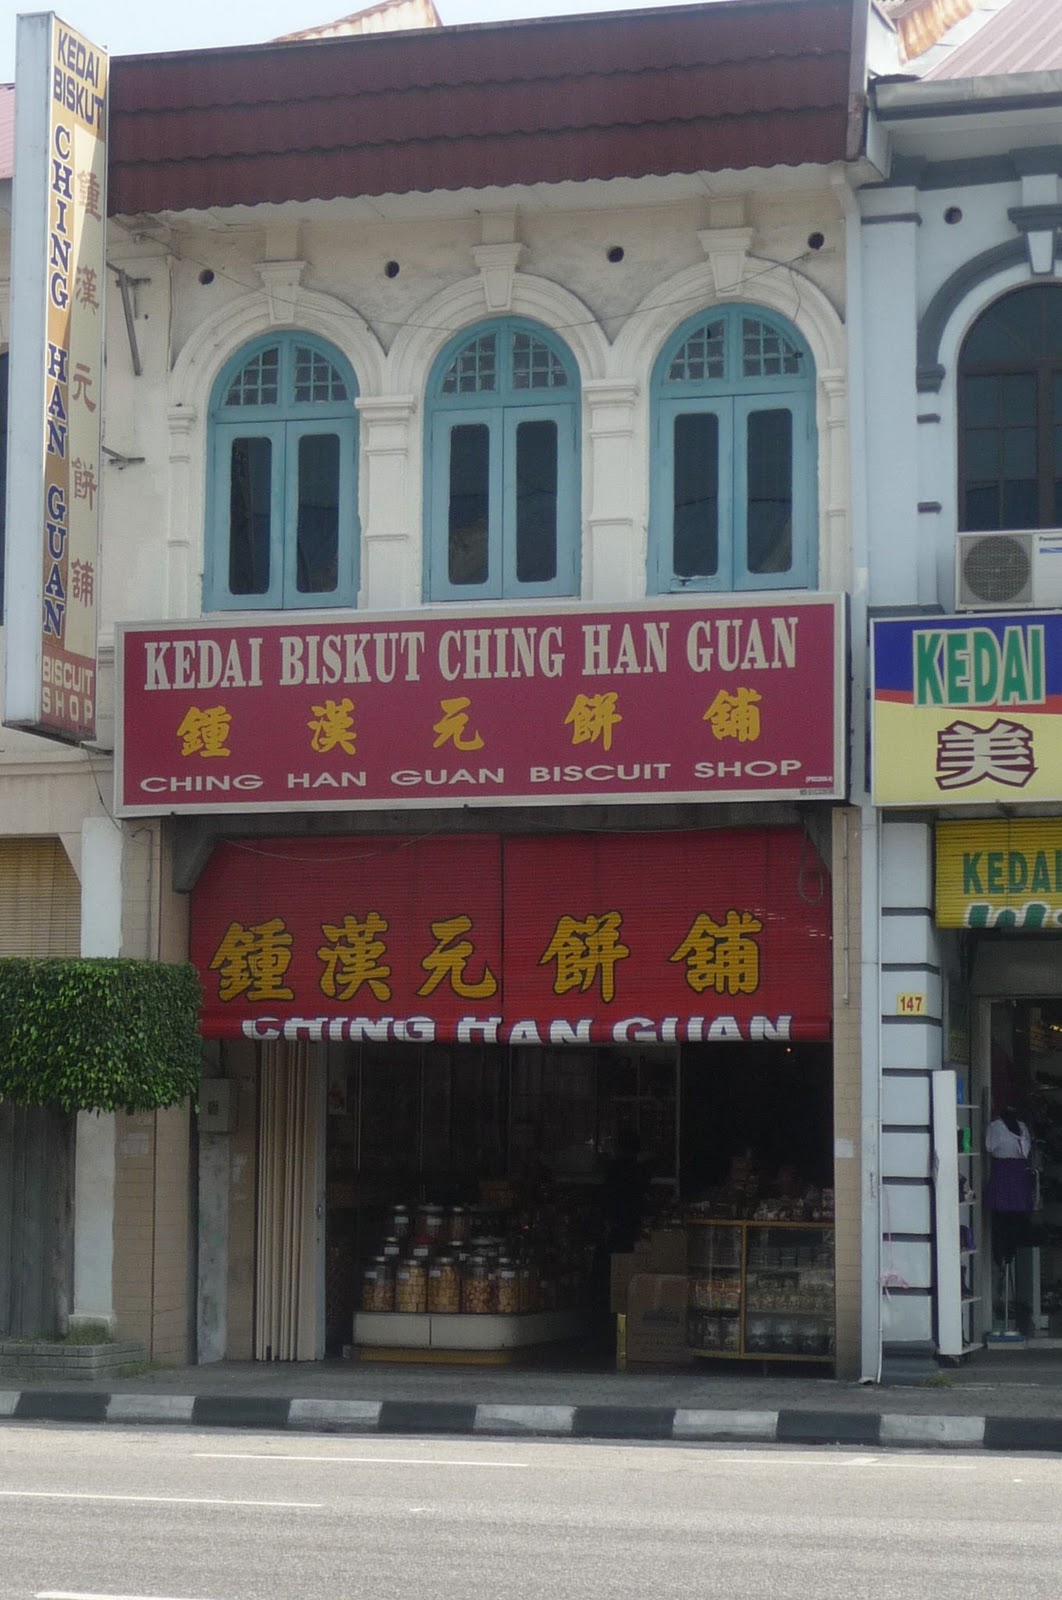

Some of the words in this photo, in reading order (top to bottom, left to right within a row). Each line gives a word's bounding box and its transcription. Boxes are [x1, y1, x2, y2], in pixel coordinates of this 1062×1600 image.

[58, 28, 100, 89] KEDAI
[53, 66, 103, 130] BISKUT
[51, 124, 73, 311] CHING
[46, 342, 69, 460] HAN
[43, 484, 68, 640] GUAN
[42, 655, 94, 695] BISCUIT
[144, 637, 264, 691] KEDAI
[279, 631, 425, 686] BISKUT
[438, 626, 565, 681] CHING
[581, 622, 670, 676] HAN
[687, 616, 799, 673] GUAN
[912, 623, 1046, 708] KEDAI
[42, 686, 93, 724] SHOP
[140, 774, 264, 793] CHING
[287, 771, 367, 788] HAN
[390, 768, 504, 787] GUAN
[530, 763, 671, 782] BISCUIT
[694, 759, 802, 778] SHOP
[934, 718, 1039, 791] 美
[962, 850, 1062, 895] KEDAI
[241, 1016, 436, 1042] CHING
[456, 1016, 594, 1045] HAN
[612, 1015, 792, 1043] GUAN
[900, 996, 922, 1011] 147
